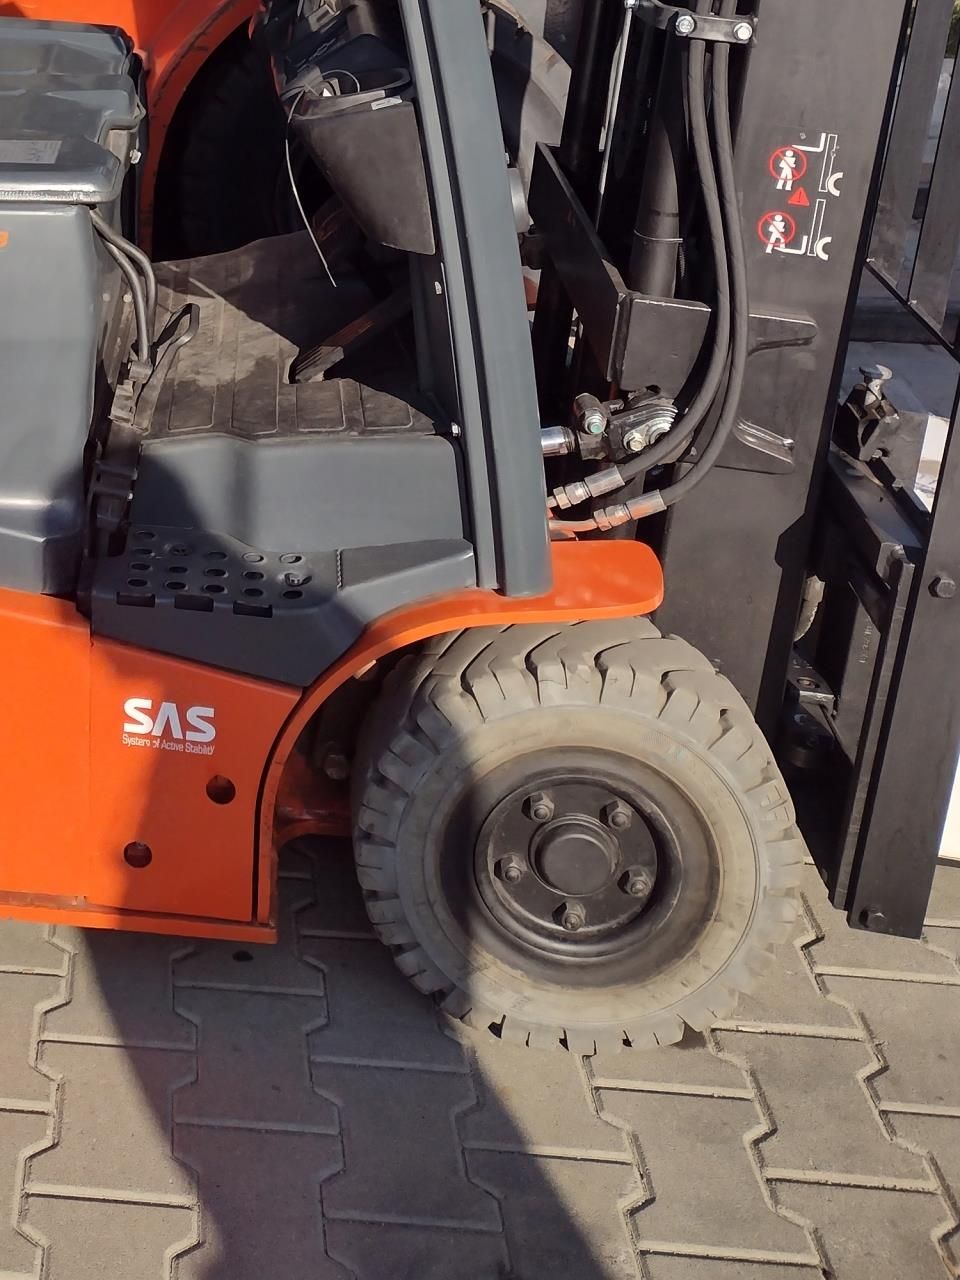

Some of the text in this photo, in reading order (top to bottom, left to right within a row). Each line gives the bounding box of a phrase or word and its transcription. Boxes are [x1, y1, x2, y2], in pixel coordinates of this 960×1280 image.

[123, 698, 216, 743] SAS
[122, 734, 151, 748] System
[161, 740, 184, 752] Active
[185, 742, 215, 756] Stability
